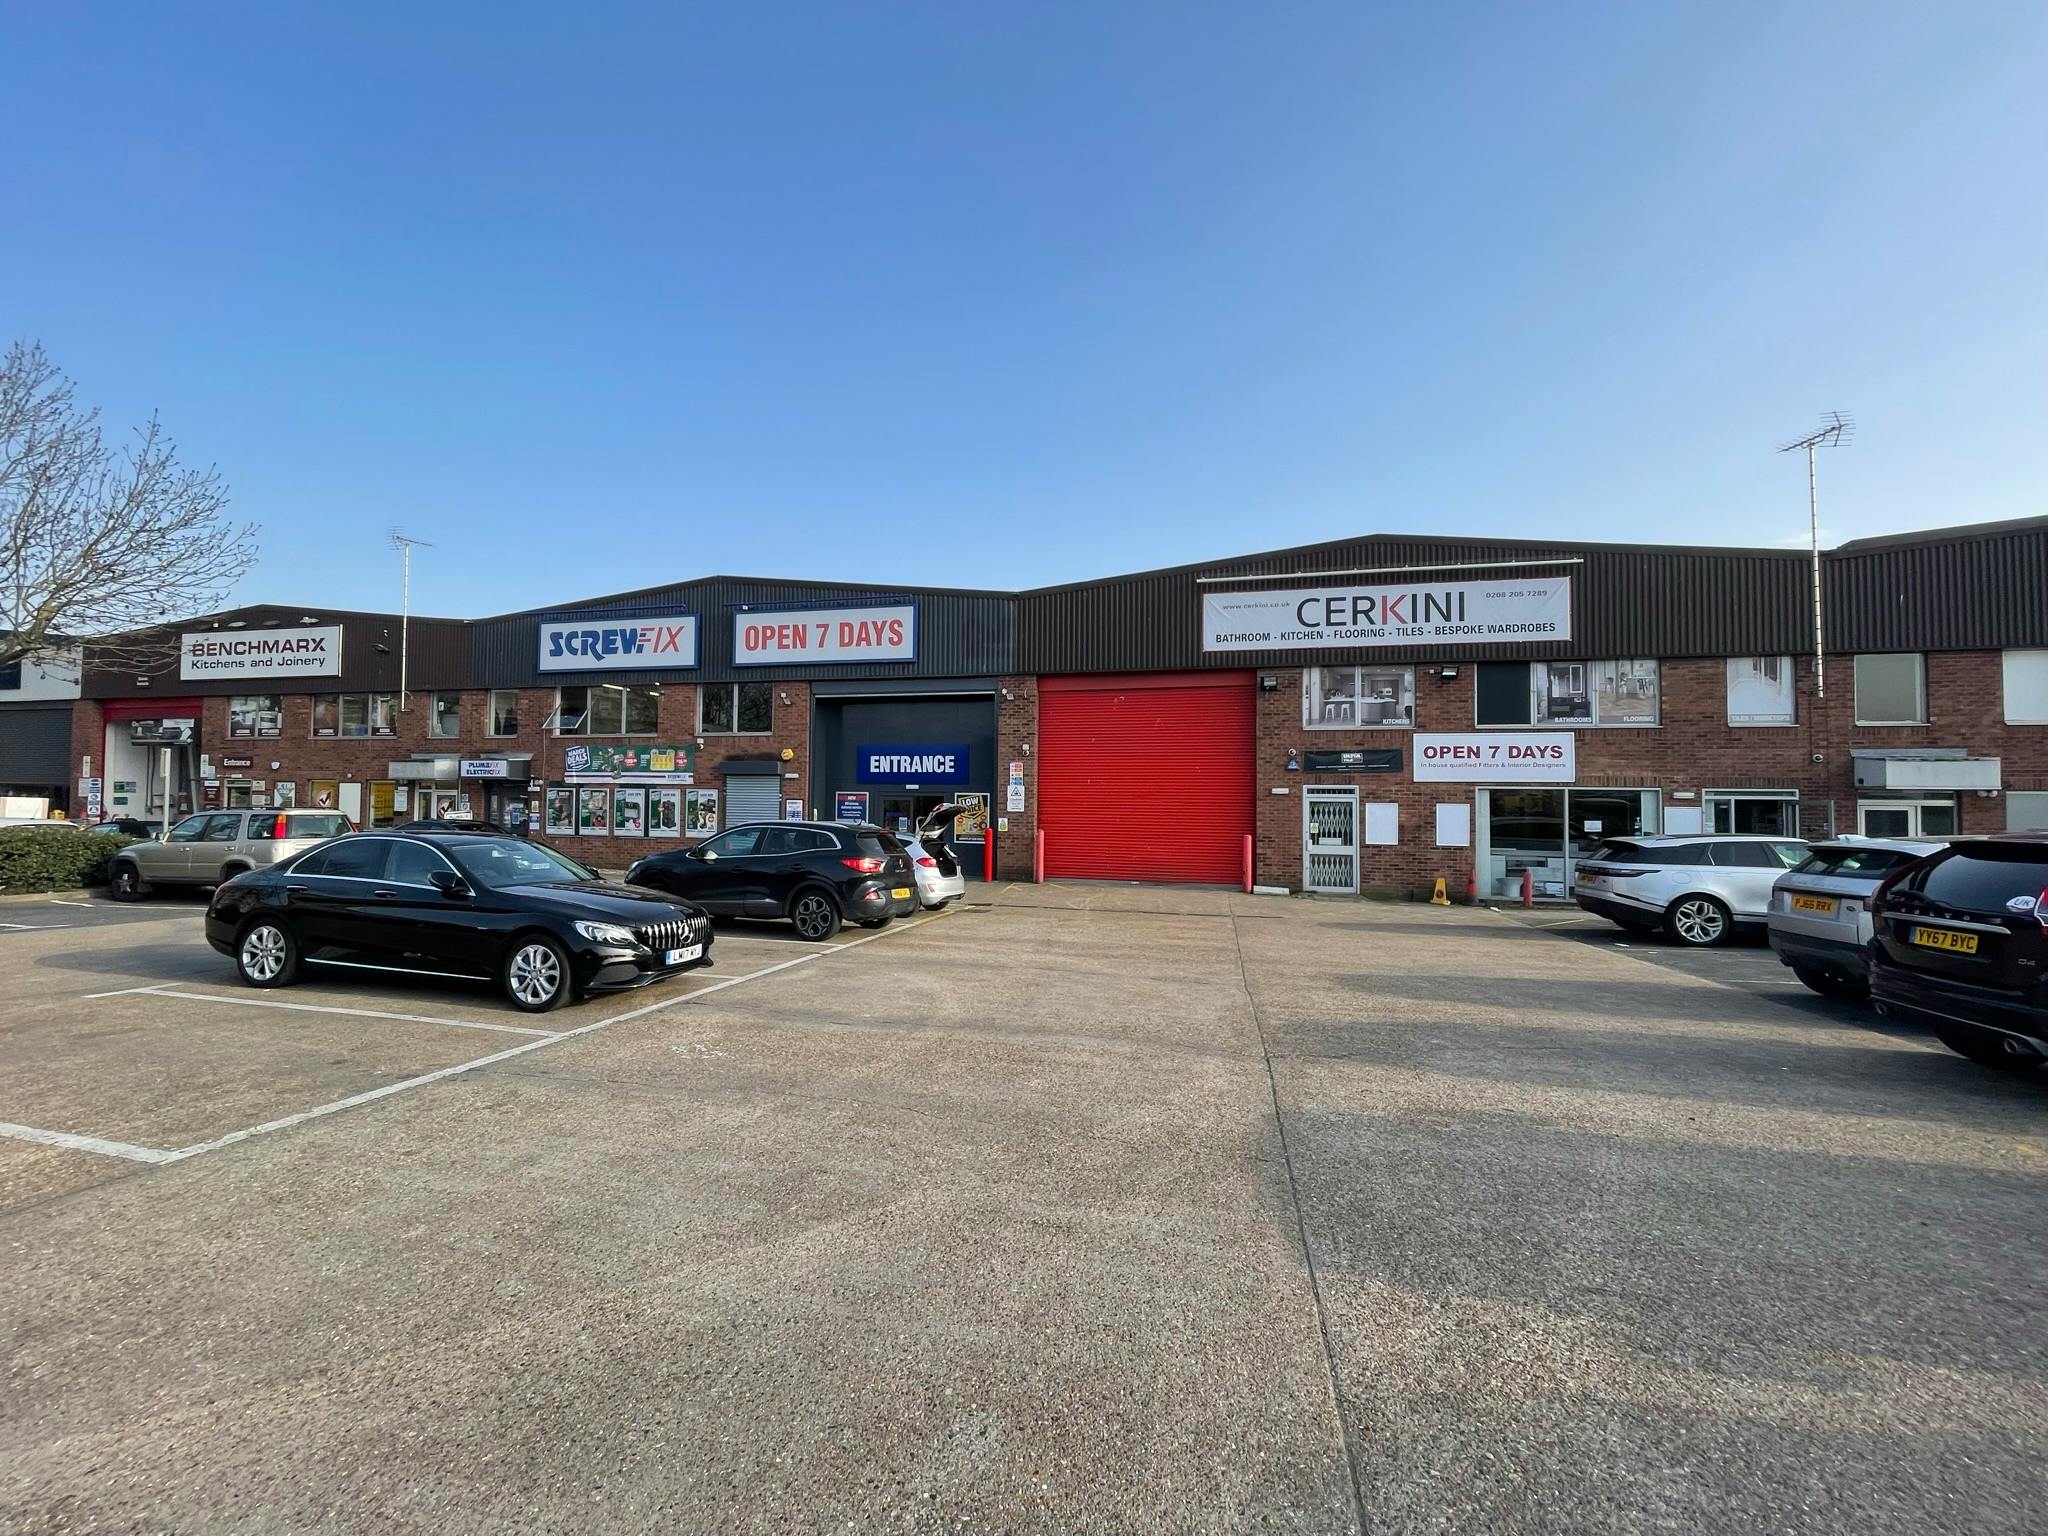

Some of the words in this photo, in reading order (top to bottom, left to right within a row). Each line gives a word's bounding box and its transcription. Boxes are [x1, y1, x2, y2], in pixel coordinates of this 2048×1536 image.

[1222, 601, 1290, 610] www.cerkini.co.uk
[1296, 591, 1465, 628] CERKINI
[744, 623, 807, 651] OPEN
[815, 623, 830, 649] 7
[839, 619, 904, 648] DAYS
[1216, 632, 1271, 643] BATHROOM
[1280, 631, 1324, 641] KITCHEN
[1334, 628, 1385, 639] FLOORING
[1395, 627, 1424, 637] TILES
[1435, 624, 1484, 635] BESPOKE
[1487, 622, 1556, 634] WARDROBES
[192, 637, 326, 657] BENCHMARX
[549, 625, 685, 662] SCREWFIX
[191, 658, 245, 669] Kitchens
[250, 657, 273, 667] and
[277, 656, 326, 668] Joinery
[567, 752, 588, 765] DEALS
[1423, 745, 1481, 759] OPEN
[1488, 745, 1500, 759] 7
[1508, 745, 1563, 759] DAYS
[224, 758, 251, 766] Entrance
[870, 755, 955, 773] ENTRANCE
[961, 796, 979, 807] LOW
[1919, 928, 1948, 945] YY67
[1950, 934, 1975, 950] BYC
